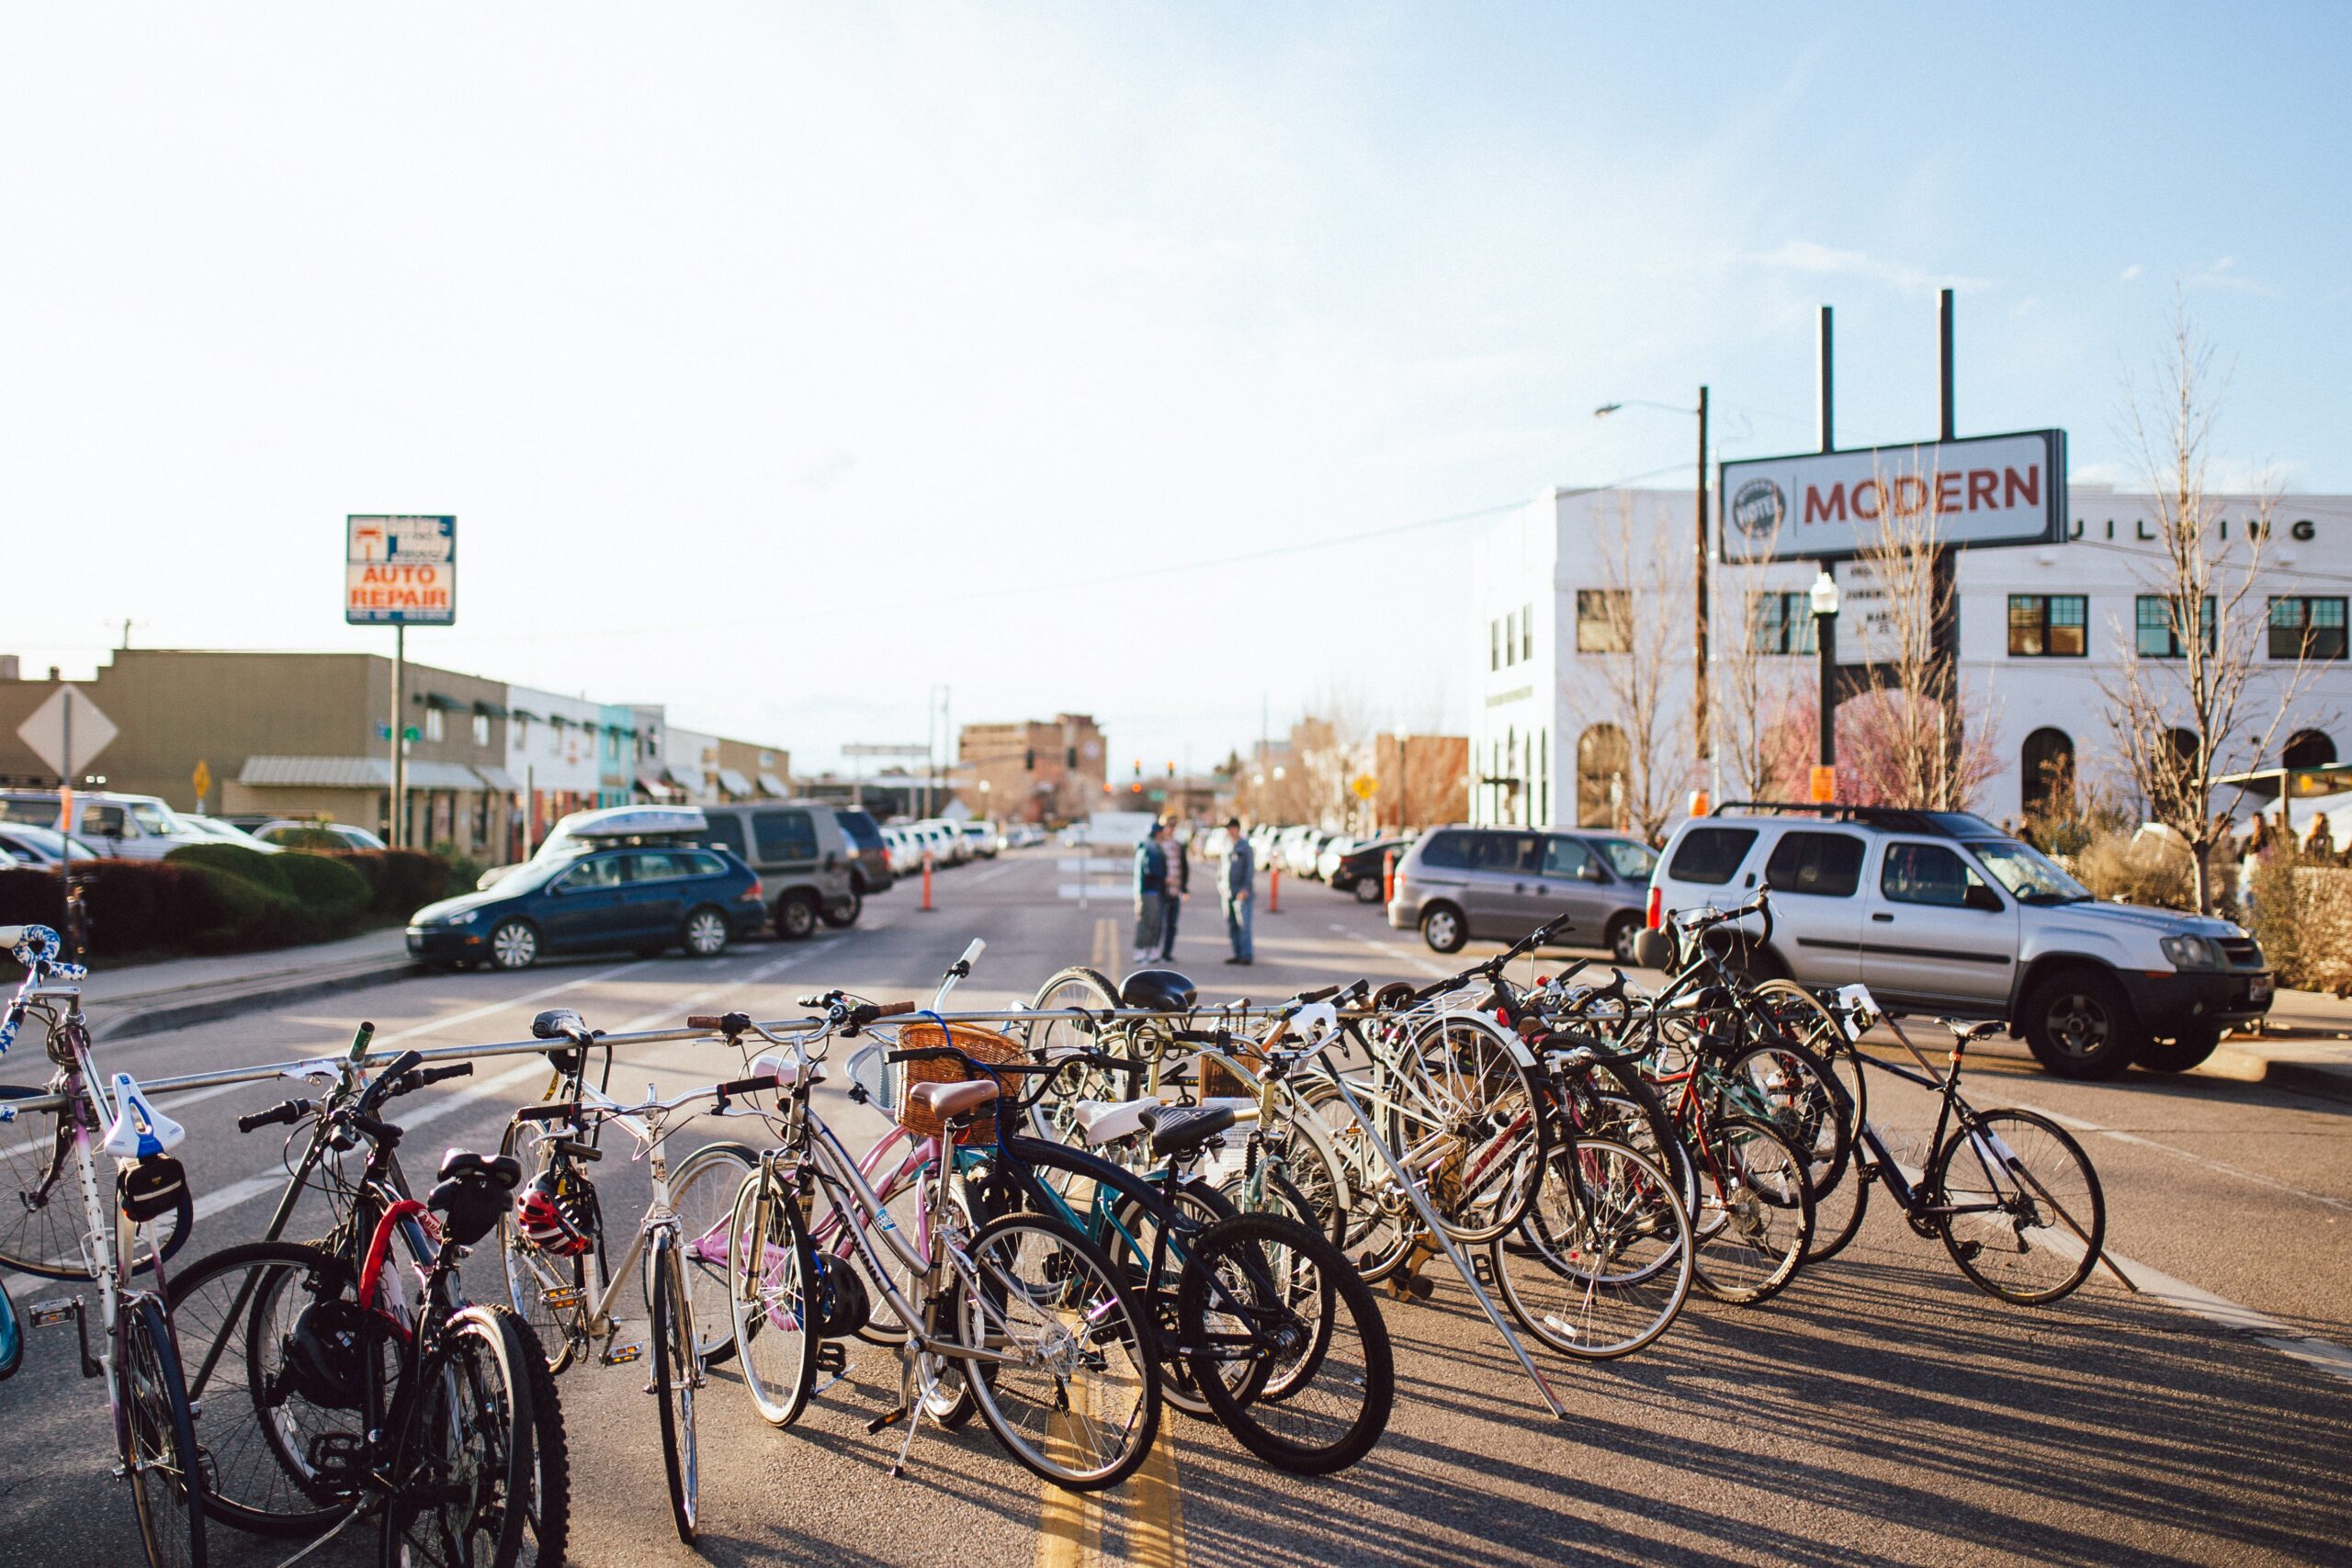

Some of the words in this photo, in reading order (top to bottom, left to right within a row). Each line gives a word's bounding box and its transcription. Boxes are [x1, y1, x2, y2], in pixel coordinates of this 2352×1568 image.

[1804, 464, 2040, 525] MODERN
[363, 563, 435, 584] AUTO
[351, 588, 447, 607] REPAIR
[834, 1201, 881, 1283] SCHWINN
